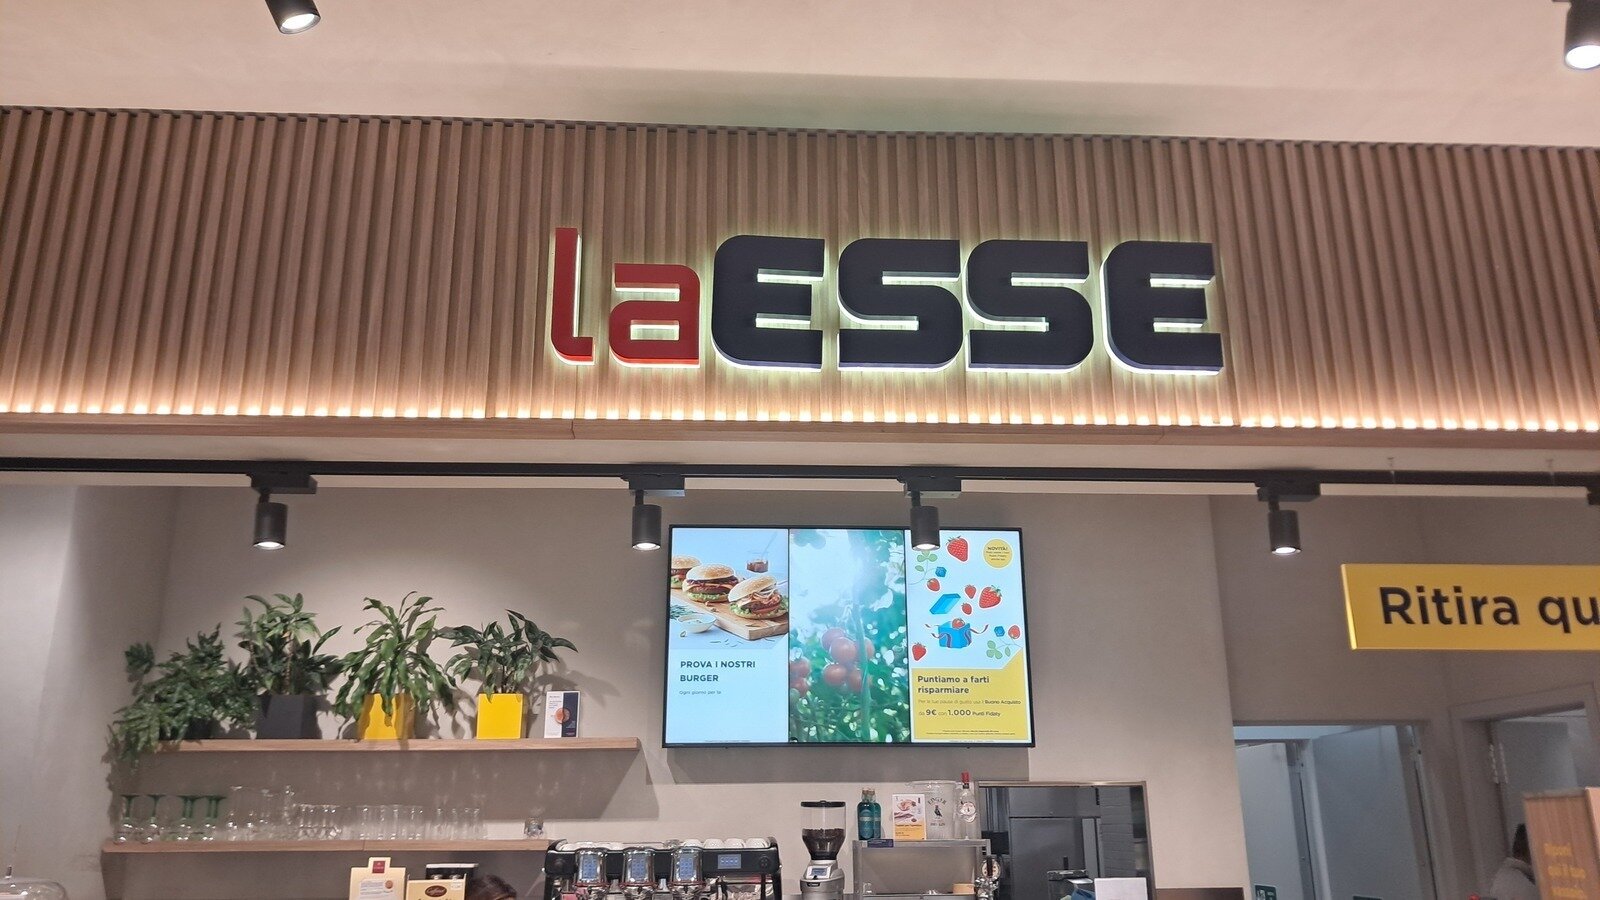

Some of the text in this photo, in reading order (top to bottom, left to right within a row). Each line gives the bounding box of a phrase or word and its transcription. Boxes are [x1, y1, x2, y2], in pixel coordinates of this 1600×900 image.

[1379, 585, 1520, 626] Ritira
[680, 660, 712, 668] PROVA
[680, 674, 719, 682] BURGER
[917, 675, 960, 683] Puntiamo
[917, 686, 970, 694] risparmiare
